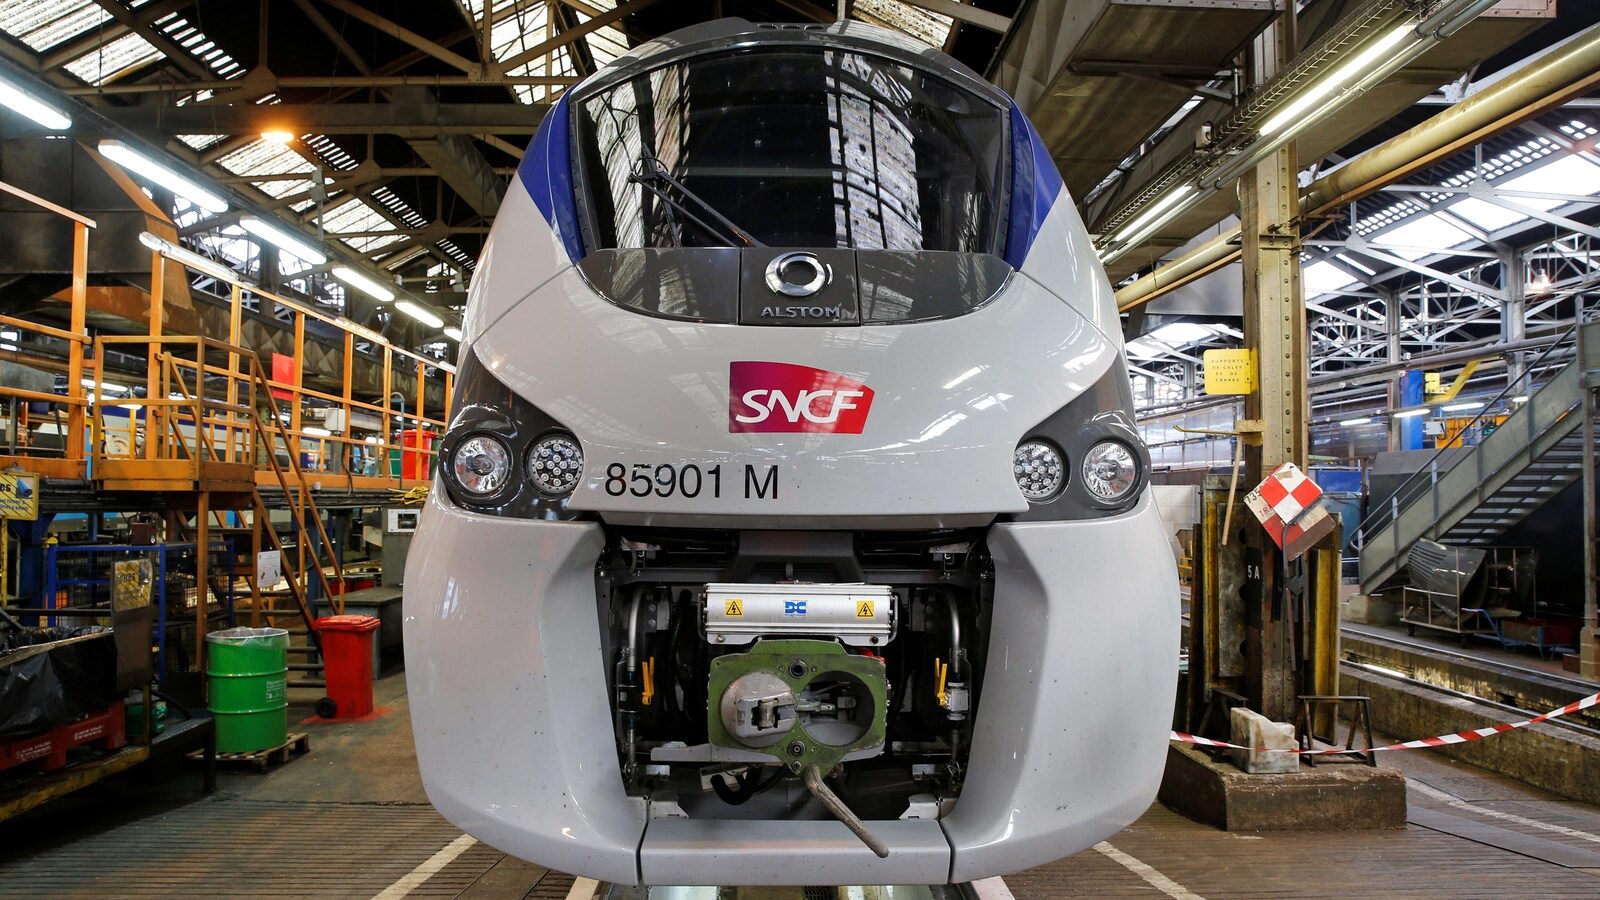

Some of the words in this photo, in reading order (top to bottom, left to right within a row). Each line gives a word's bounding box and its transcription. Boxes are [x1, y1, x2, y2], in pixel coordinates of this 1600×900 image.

[760, 306, 840, 318] ALSTOM
[734, 389, 865, 424] SNCF
[604, 462, 721, 499] 85901
[744, 464, 779, 500] M
